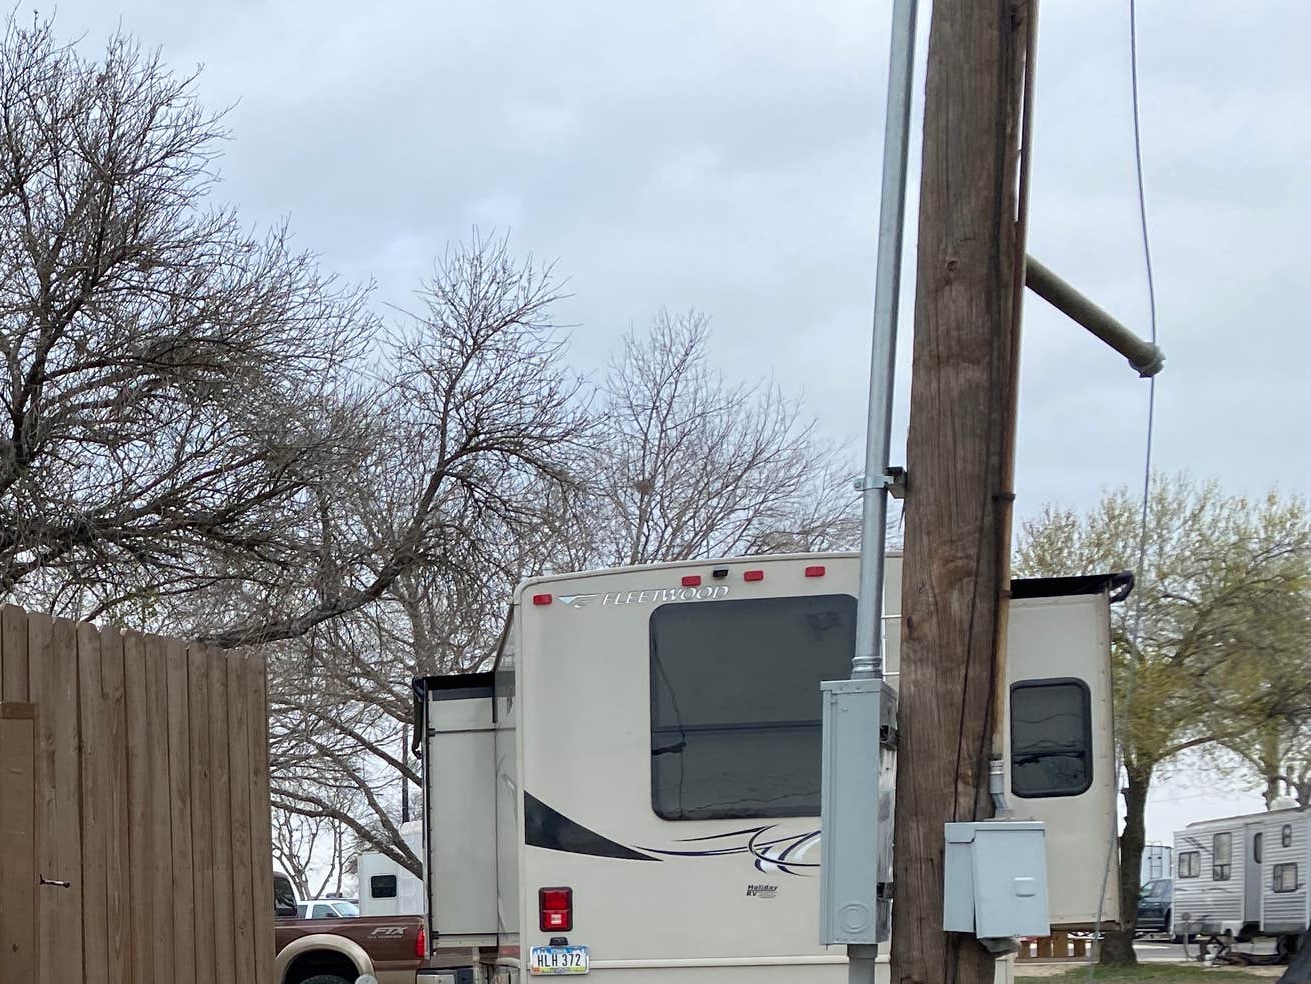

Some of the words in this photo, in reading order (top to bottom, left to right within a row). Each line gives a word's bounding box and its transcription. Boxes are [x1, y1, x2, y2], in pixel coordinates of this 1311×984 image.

[602, 586, 729, 605] FLEETWOOD
[371, 926, 408, 934] FTX
[537, 954, 557, 967] HLH
[561, 953, 581, 967] 372
